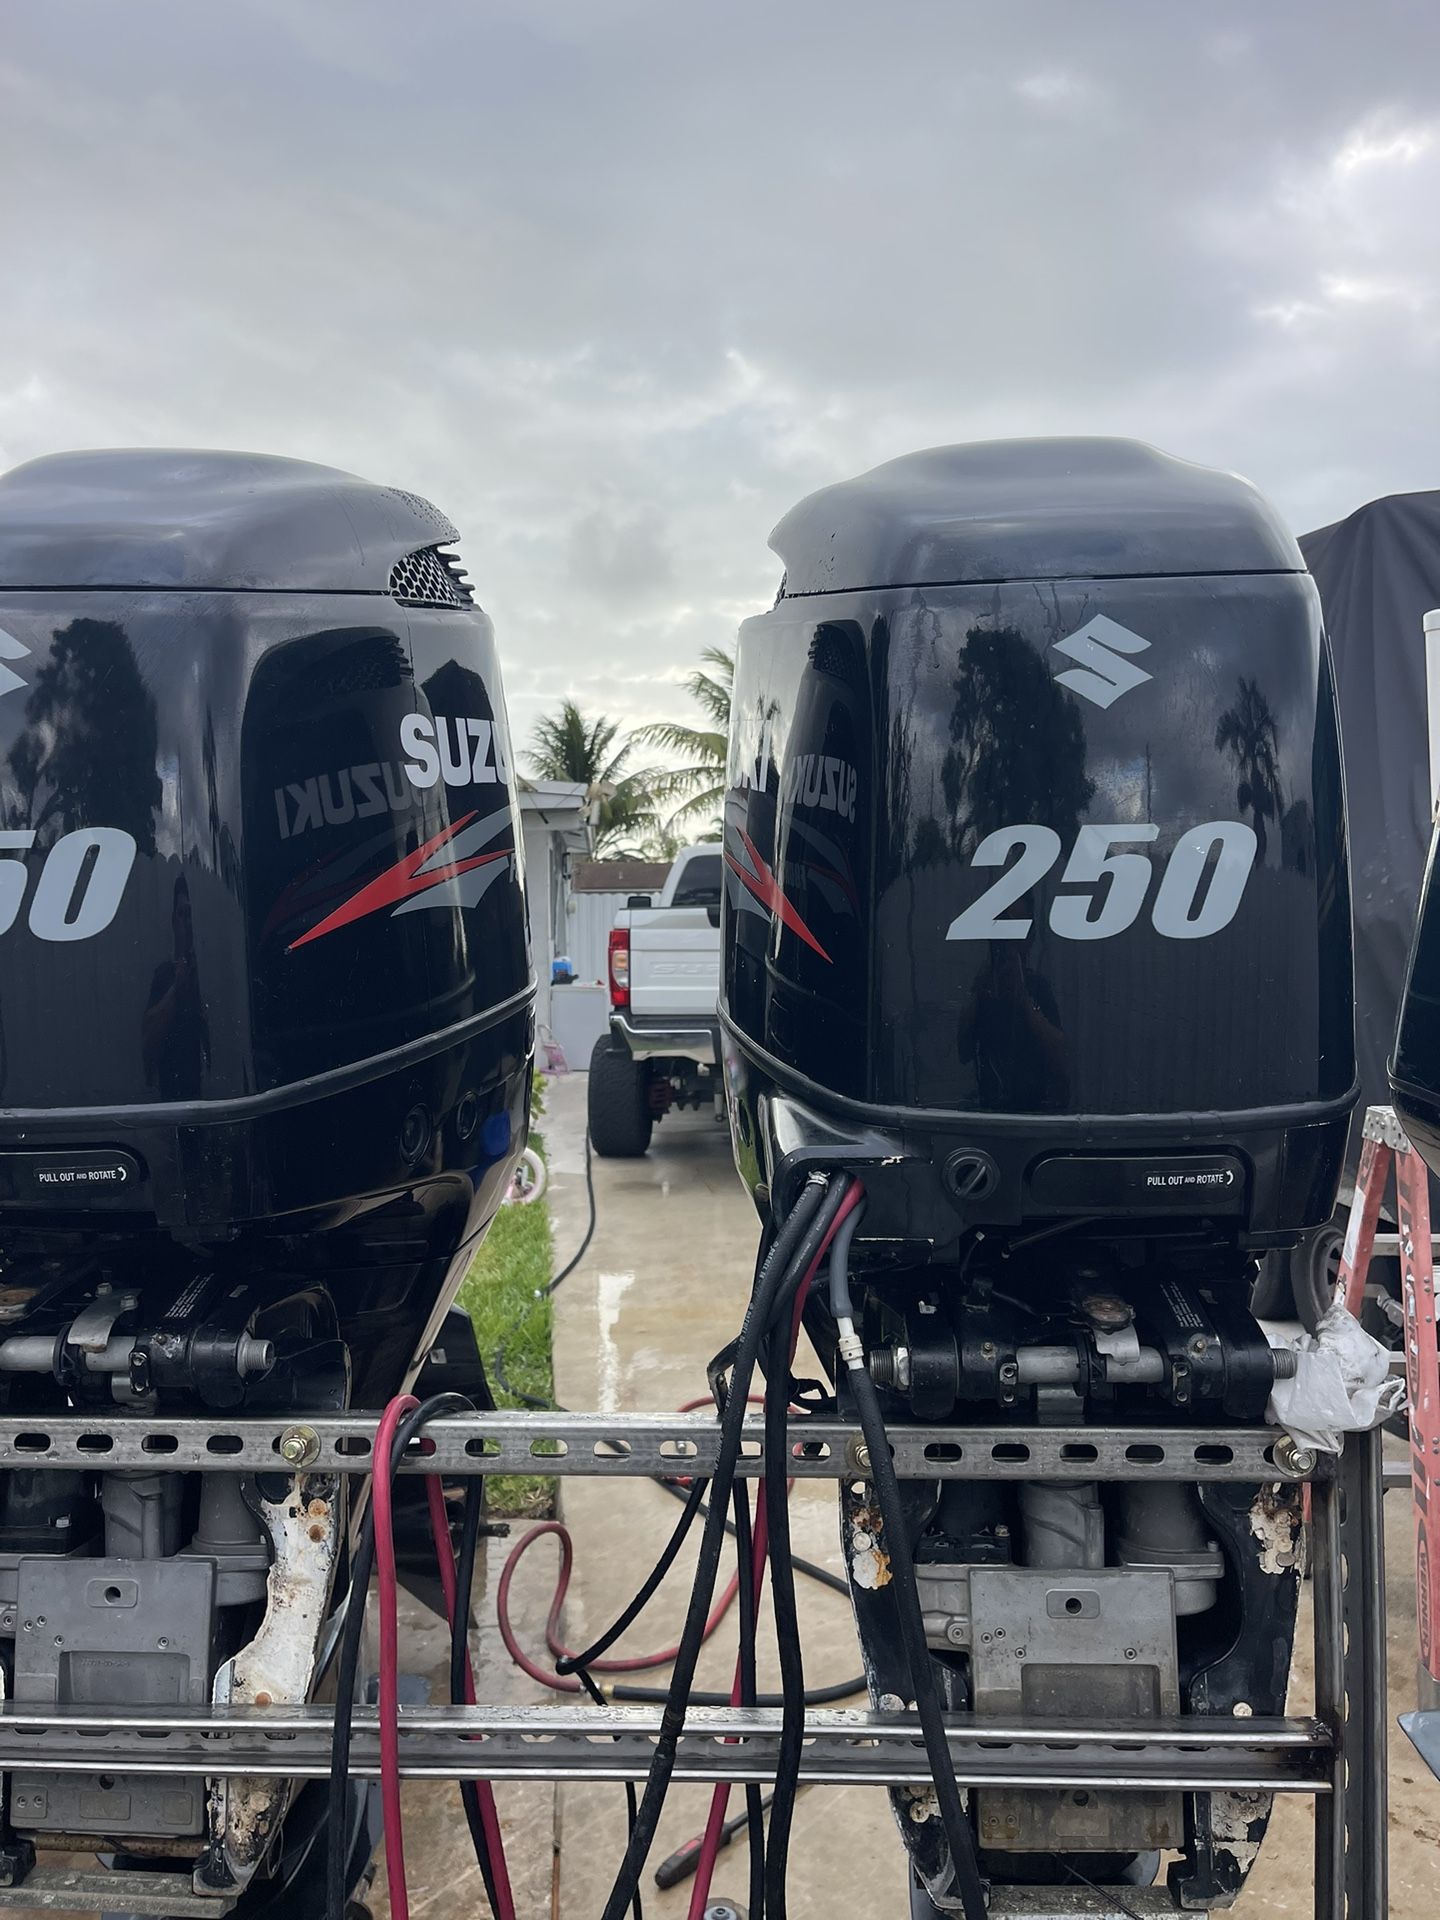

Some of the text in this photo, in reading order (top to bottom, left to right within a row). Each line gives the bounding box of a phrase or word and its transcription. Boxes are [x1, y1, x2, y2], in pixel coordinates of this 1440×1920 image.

[945, 821, 1258, 941] 250
[39, 1174, 58, 1182] PULL
[60, 1172, 74, 1181] OUT
[88, 1170, 116, 1180] ROTATE
[1147, 1177, 1166, 1185] PULL
[1168, 1176, 1183, 1185] OUT
[1196, 1174, 1223, 1184] ROTATE
